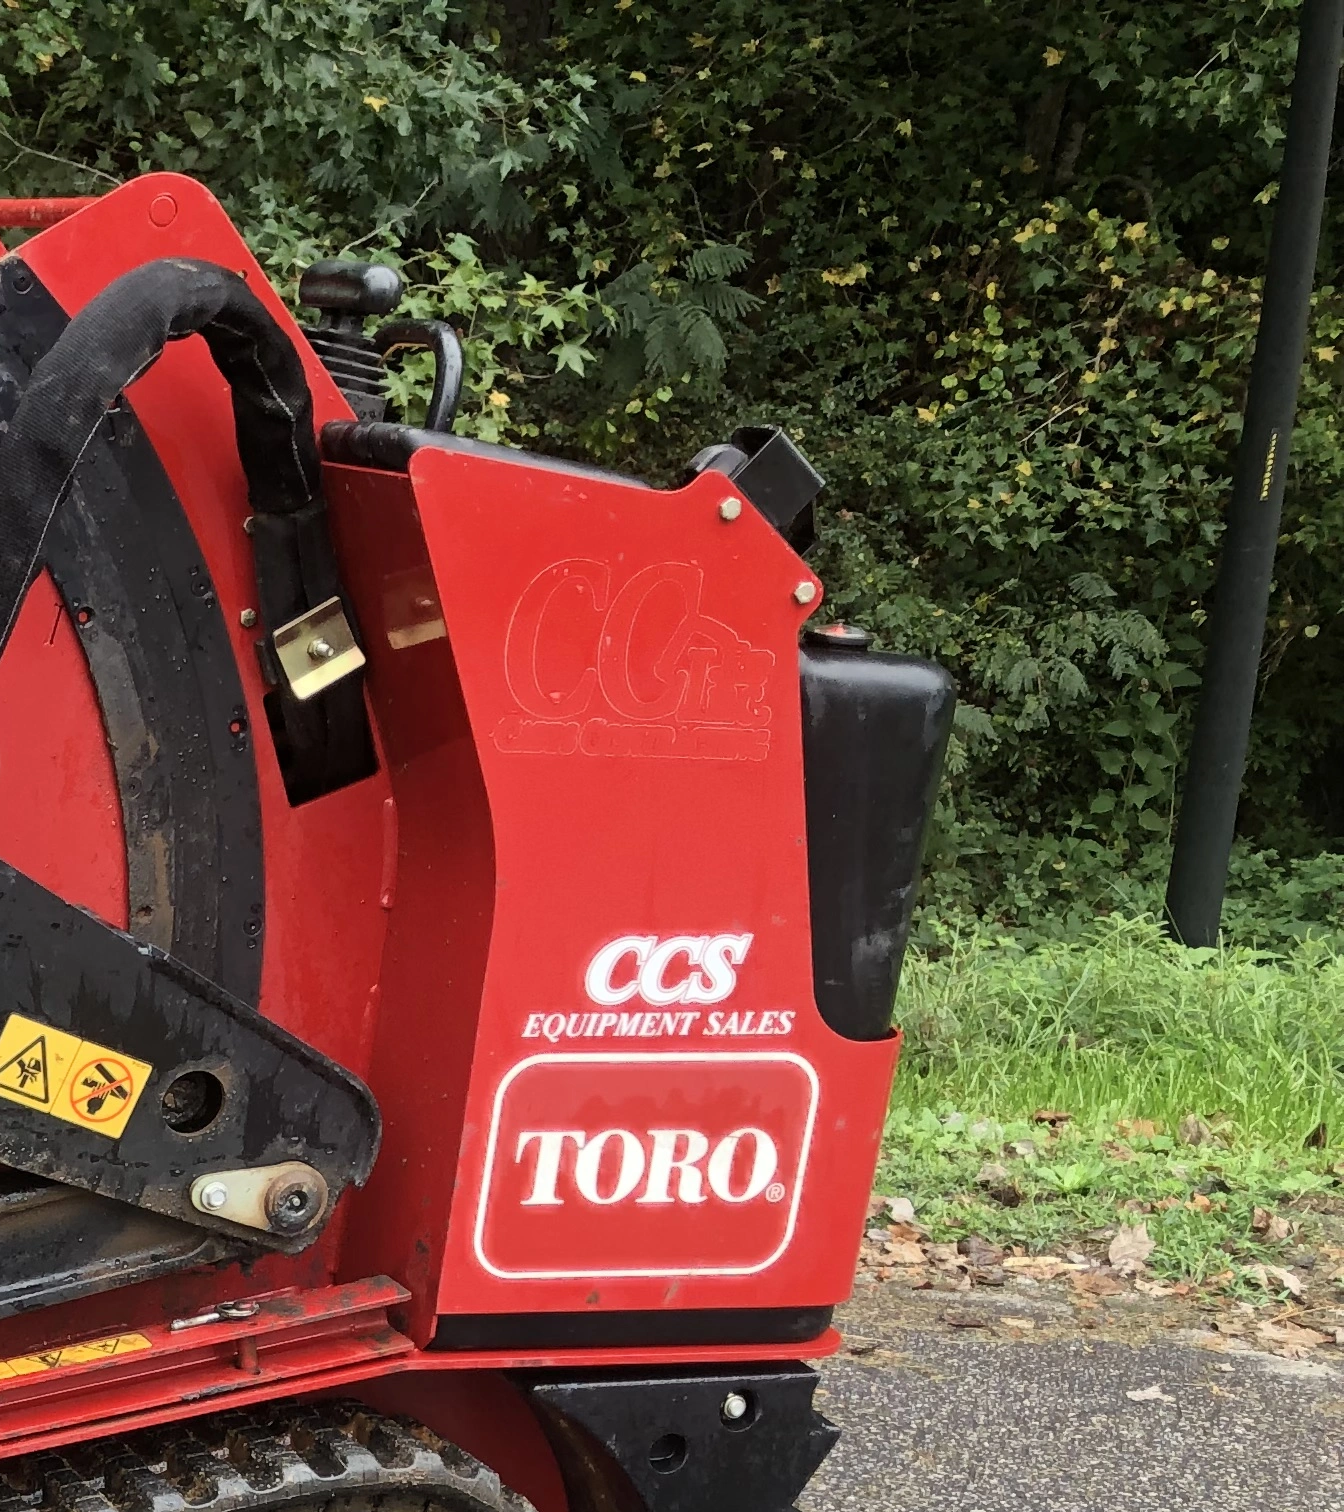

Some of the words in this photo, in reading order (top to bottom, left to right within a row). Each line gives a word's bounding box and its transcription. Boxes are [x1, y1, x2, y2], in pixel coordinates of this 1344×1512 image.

[584, 932, 755, 1007] CCS
[521, 1012, 701, 1043] EQUIPMENT
[703, 1011, 796, 1036] SALES
